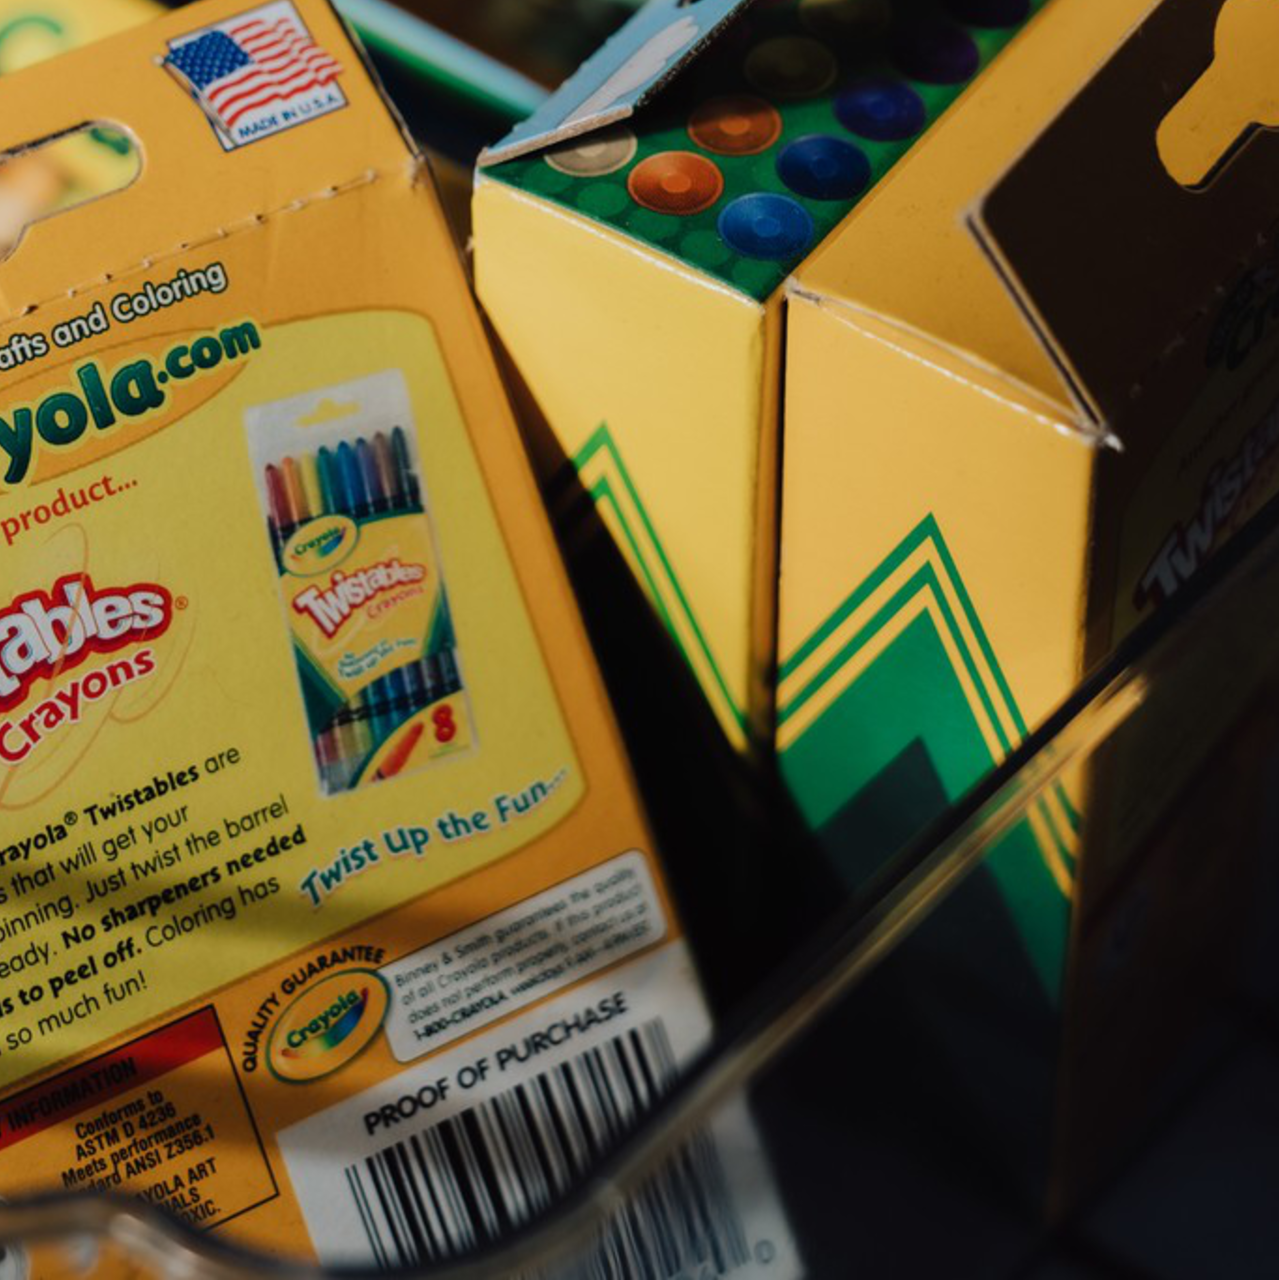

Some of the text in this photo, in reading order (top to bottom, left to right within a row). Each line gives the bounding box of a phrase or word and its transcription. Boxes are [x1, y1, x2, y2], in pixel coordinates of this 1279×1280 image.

[239, 116, 278, 138] MADE
[52, 304, 109, 347] and
[111, 262, 228, 323] Coloring
[1, 472, 138, 545] product...
[291, 558, 426, 639] Twistables
[431, 703, 457, 745] 8
[83, 765, 200, 827] Twistables
[204, 747, 242, 774] are
[10, 863, 58, 897] that
[60, 841, 98, 875] will
[102, 826, 138, 862] get
[141, 805, 189, 844] your
[61, 923, 96, 950] No
[100, 866, 222, 933] sharpeners
[225, 824, 307, 877] needed
[86, 867, 128, 903] Just
[131, 844, 182, 881] twist
[185, 830, 222, 857] the
[224, 793, 290, 840] barrel
[300, 836, 379, 907] Twist
[436, 811, 489, 841] the
[18, 984, 44, 1006] to
[48, 955, 99, 999] peel
[102, 936, 143, 969] off.
[145, 896, 237, 949] Coloring
[238, 877, 281, 907] has
[442, 951, 452, 965] &
[6, 1026, 33, 1051] so
[37, 993, 101, 1036] much
[103, 969, 148, 1006] fun!
[242, 944, 386, 1073] QUALITY GUARANTEE
[286, 988, 362, 1050] Crayola
[7, 1056, 138, 1134] INFORMATION
[363, 991, 631, 1137] PROOF OF PURCHASE
[60, 1113, 204, 1189] Meets performance
[75, 1088, 165, 1141] Conforms to
[75, 1101, 178, 1162] ASTM D 4236
[125, 1148, 162, 1180] ANSI
[186, 1156, 219, 1186] ART
